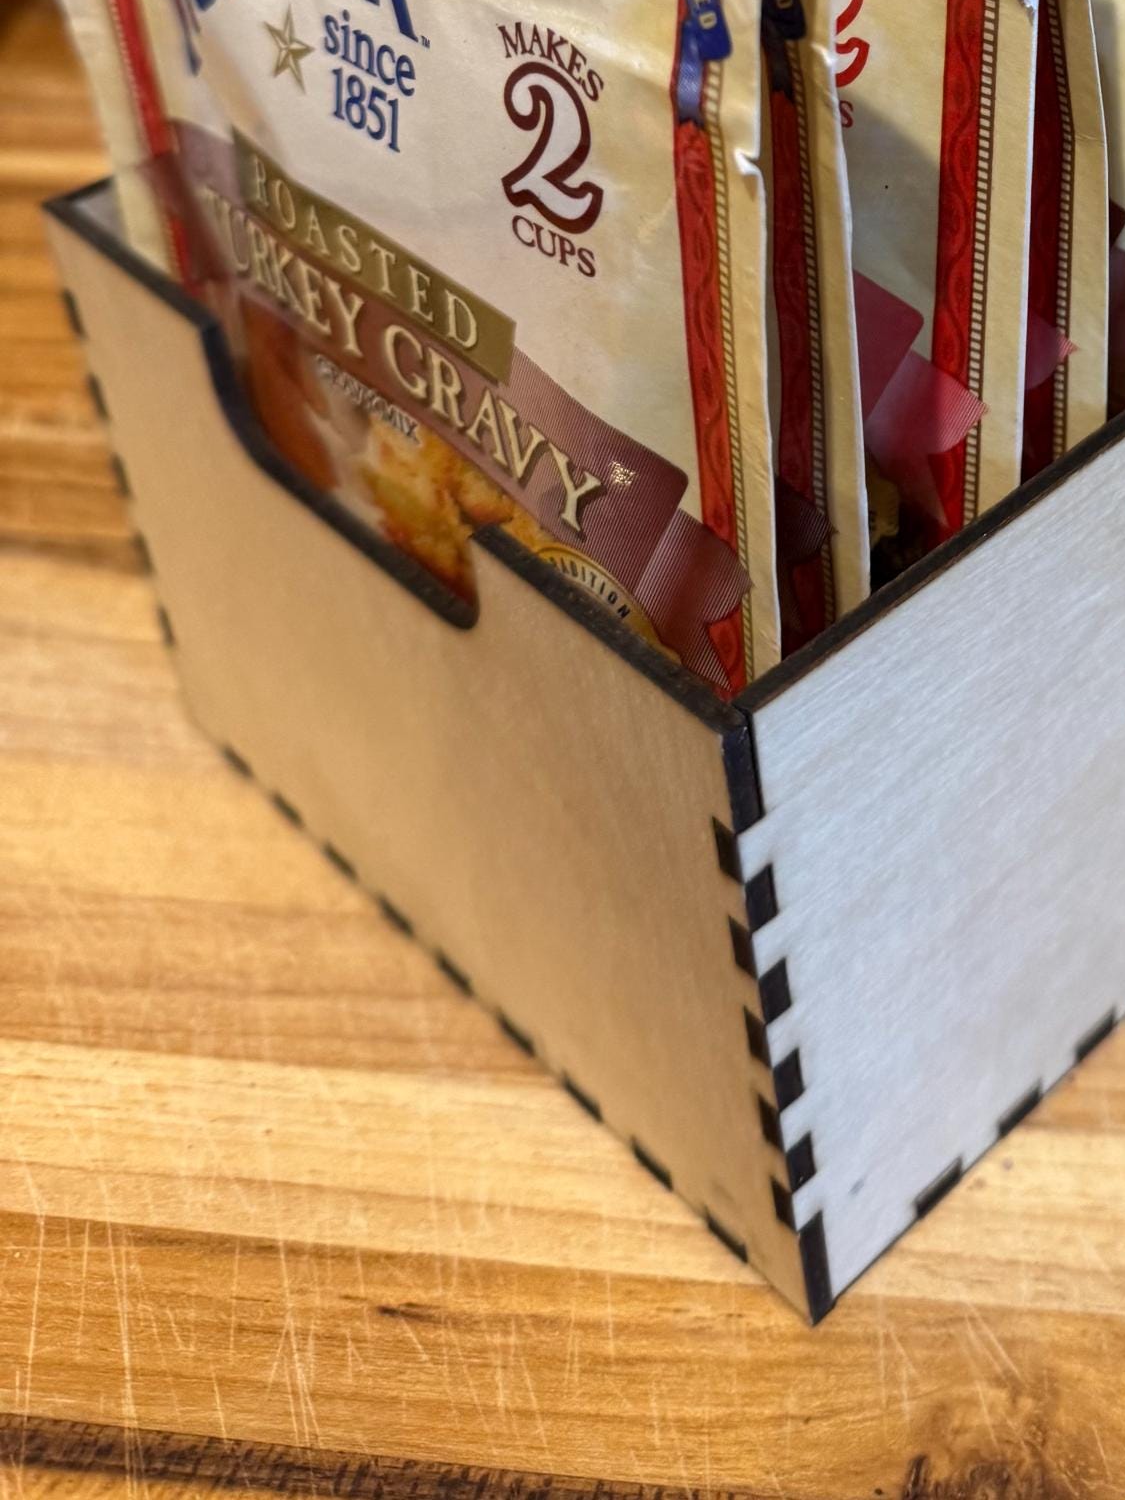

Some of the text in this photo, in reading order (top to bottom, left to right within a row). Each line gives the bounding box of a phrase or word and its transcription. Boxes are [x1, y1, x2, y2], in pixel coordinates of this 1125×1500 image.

[323, 9, 416, 97] since
[496, 21, 604, 102] MAKES
[331, 67, 401, 153] 1851
[501, 61, 604, 235] 2
[252, 154, 478, 349] ROASTED
[511, 214, 597, 278] CUPS
[384, 323, 602, 534] GRAVY
